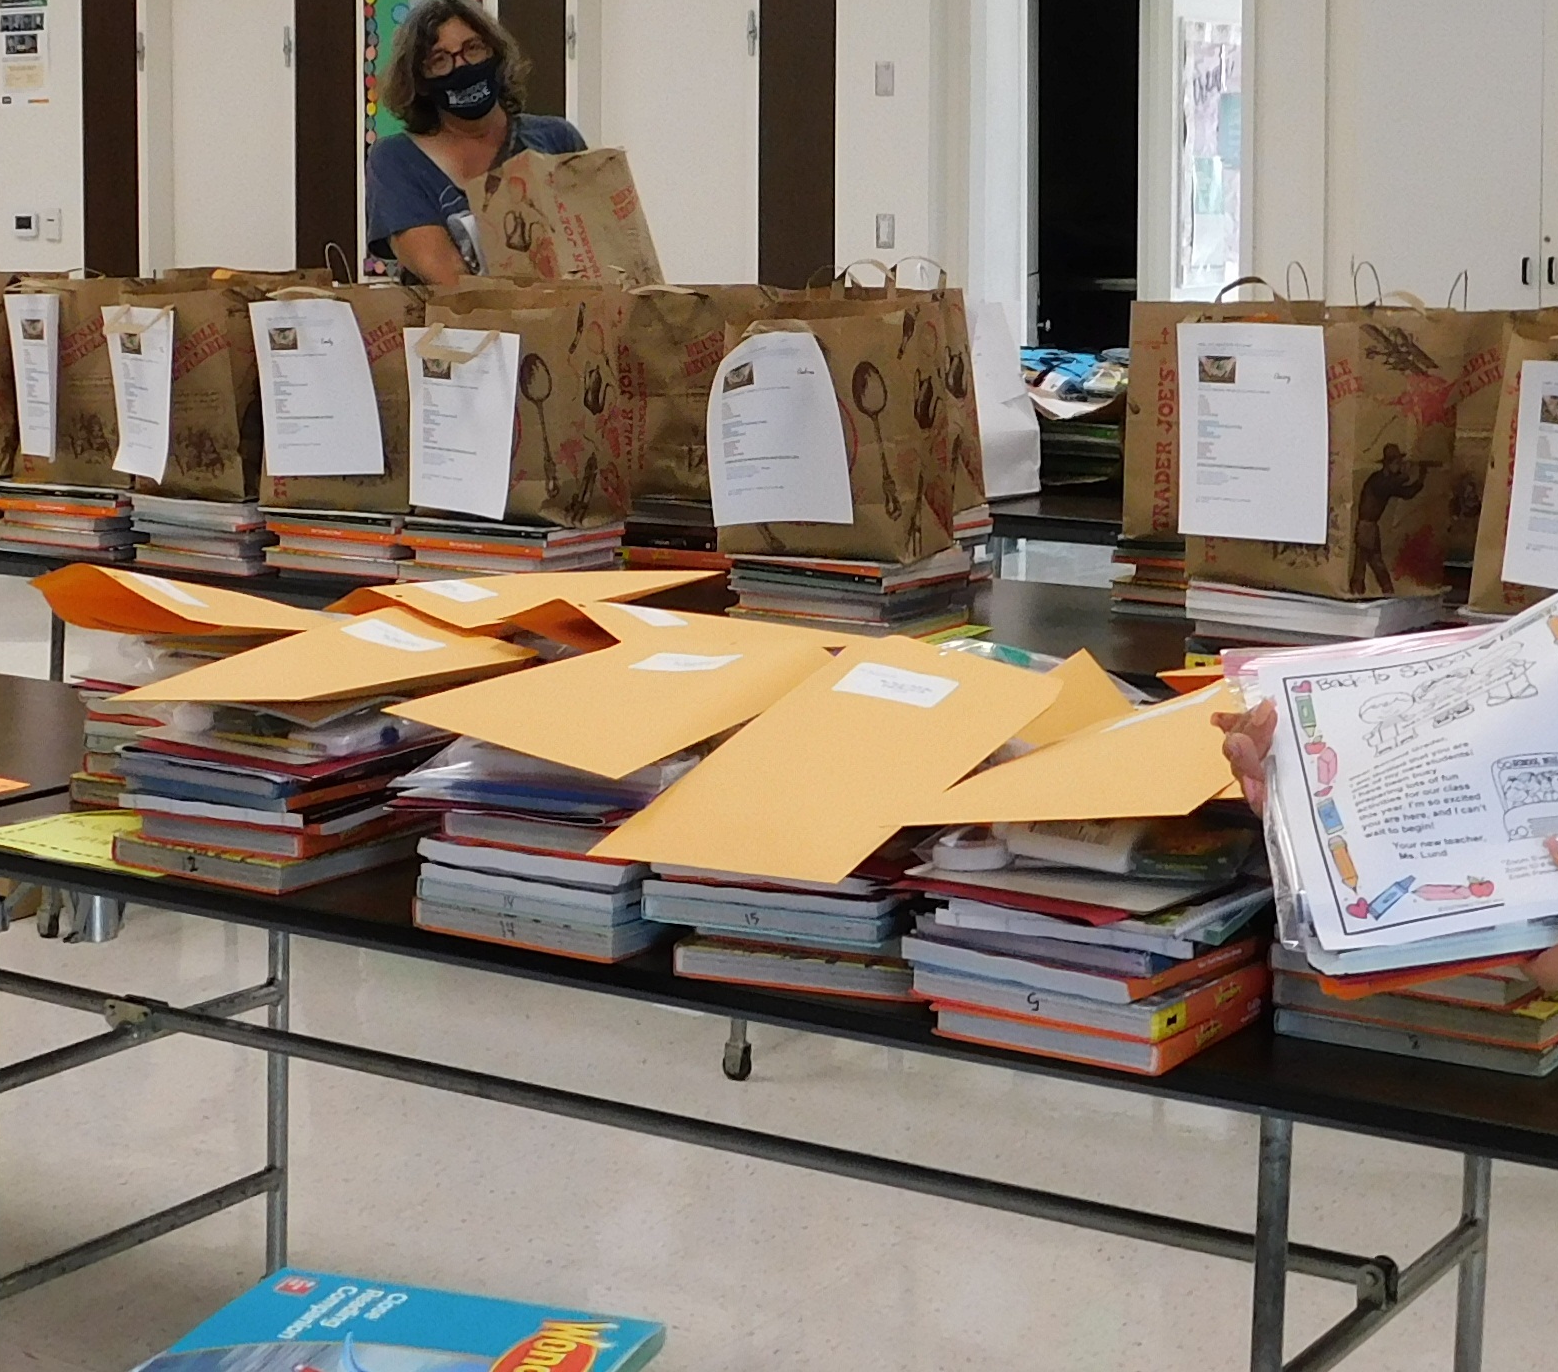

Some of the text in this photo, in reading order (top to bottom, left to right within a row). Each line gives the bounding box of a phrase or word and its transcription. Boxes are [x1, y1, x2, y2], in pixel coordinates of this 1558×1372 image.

[1152, 366, 1176, 531] TRADER JOE'S
[1316, 651, 1473, 692] Back to School
[1362, 821, 1380, 831] you
[1433, 808, 1451, 817] and
[1461, 804, 1486, 814] can't
[1365, 829, 1385, 838] wait
[1402, 822, 1435, 833] begin!
[1420, 850, 1447, 858] Lund
[744, 912, 760, 926] 15
[277, 1285, 359, 1340] Companion
